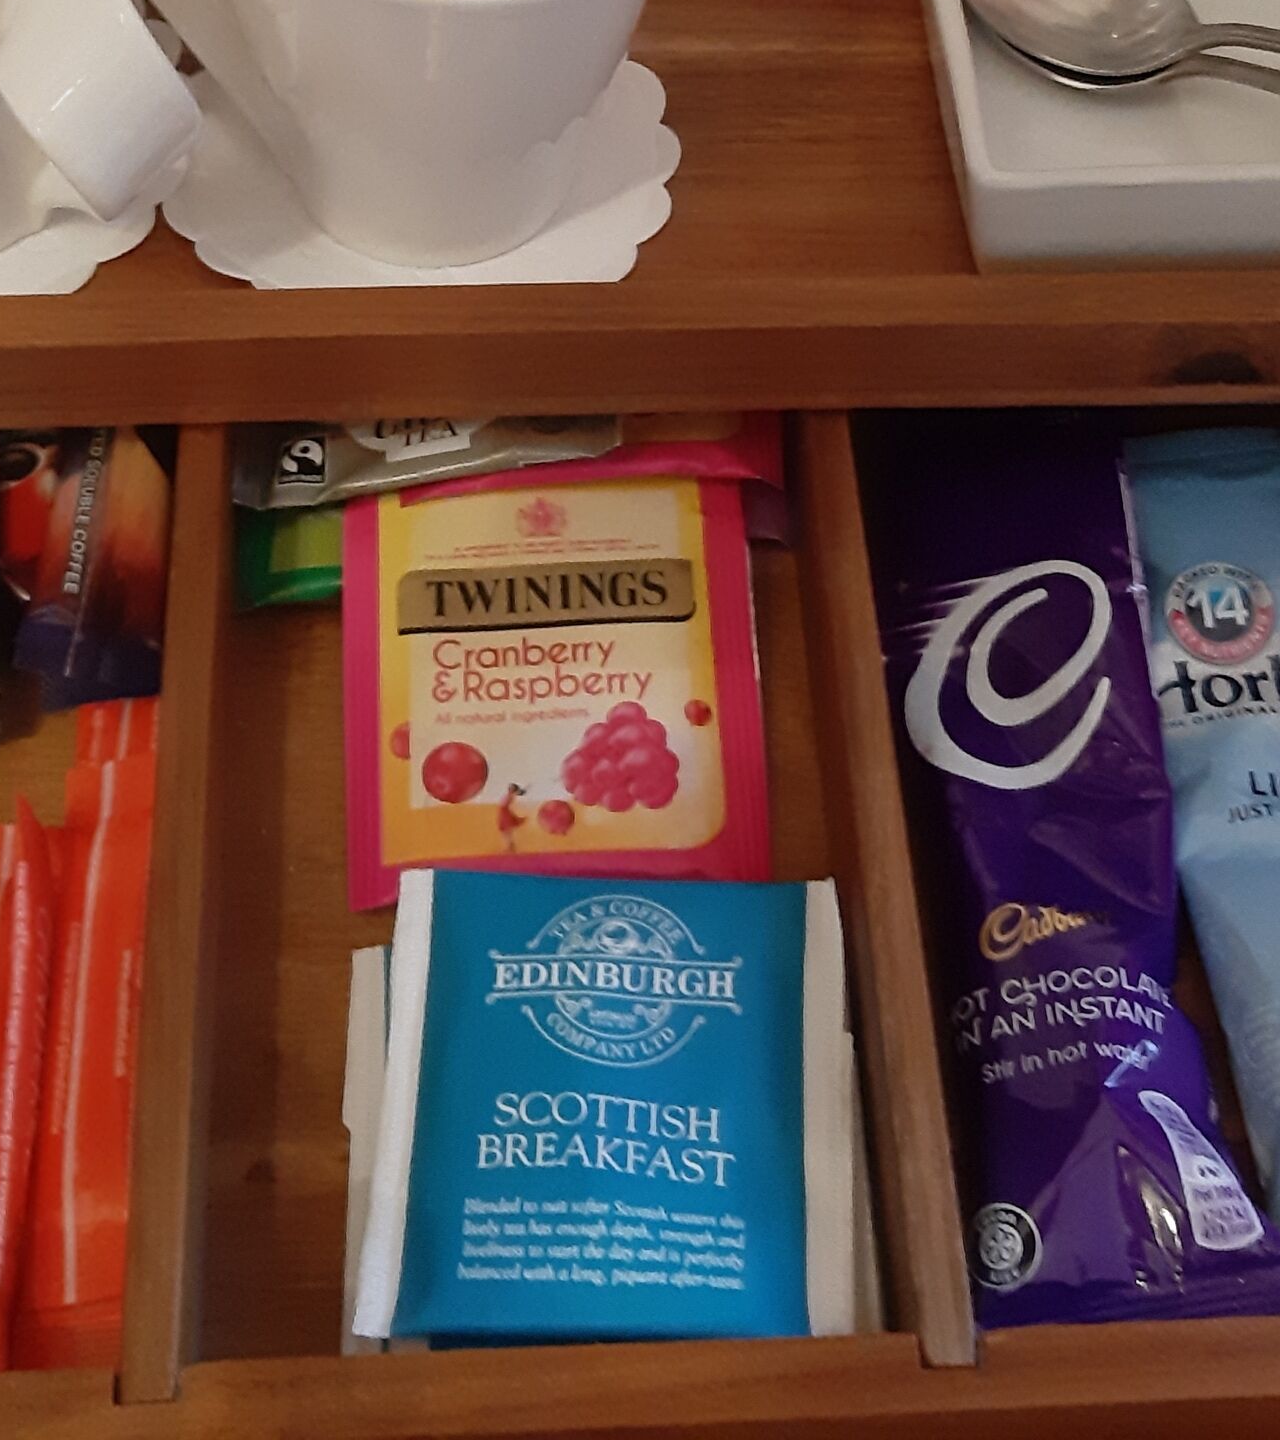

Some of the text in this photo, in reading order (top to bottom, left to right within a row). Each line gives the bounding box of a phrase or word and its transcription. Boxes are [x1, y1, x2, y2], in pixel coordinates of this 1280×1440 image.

[75, 459, 103, 526] SOLUBLE
[63, 529, 88, 595] COFFEE
[426, 569, 669, 617] TWININGS
[1185, 585, 1251, 630] 14
[432, 637, 616, 670] Cranberry
[463, 665, 653, 704] Raspberry
[1227, 803, 1273, 825] JUST
[492, 959, 736, 1000] EDINBURGH
[952, 986, 991, 1022] OT
[991, 1008, 1037, 1040] AN
[1045, 996, 1167, 1035] INSTANT
[546, 1012, 636, 1059] COMPANY
[639, 1025, 678, 1057] LTD
[1021, 1053, 1044, 1074] in
[1047, 1041, 1088, 1066] hot
[492, 1090, 721, 1144] SCOTTISH
[477, 1131, 737, 1188] BREAKFAST
